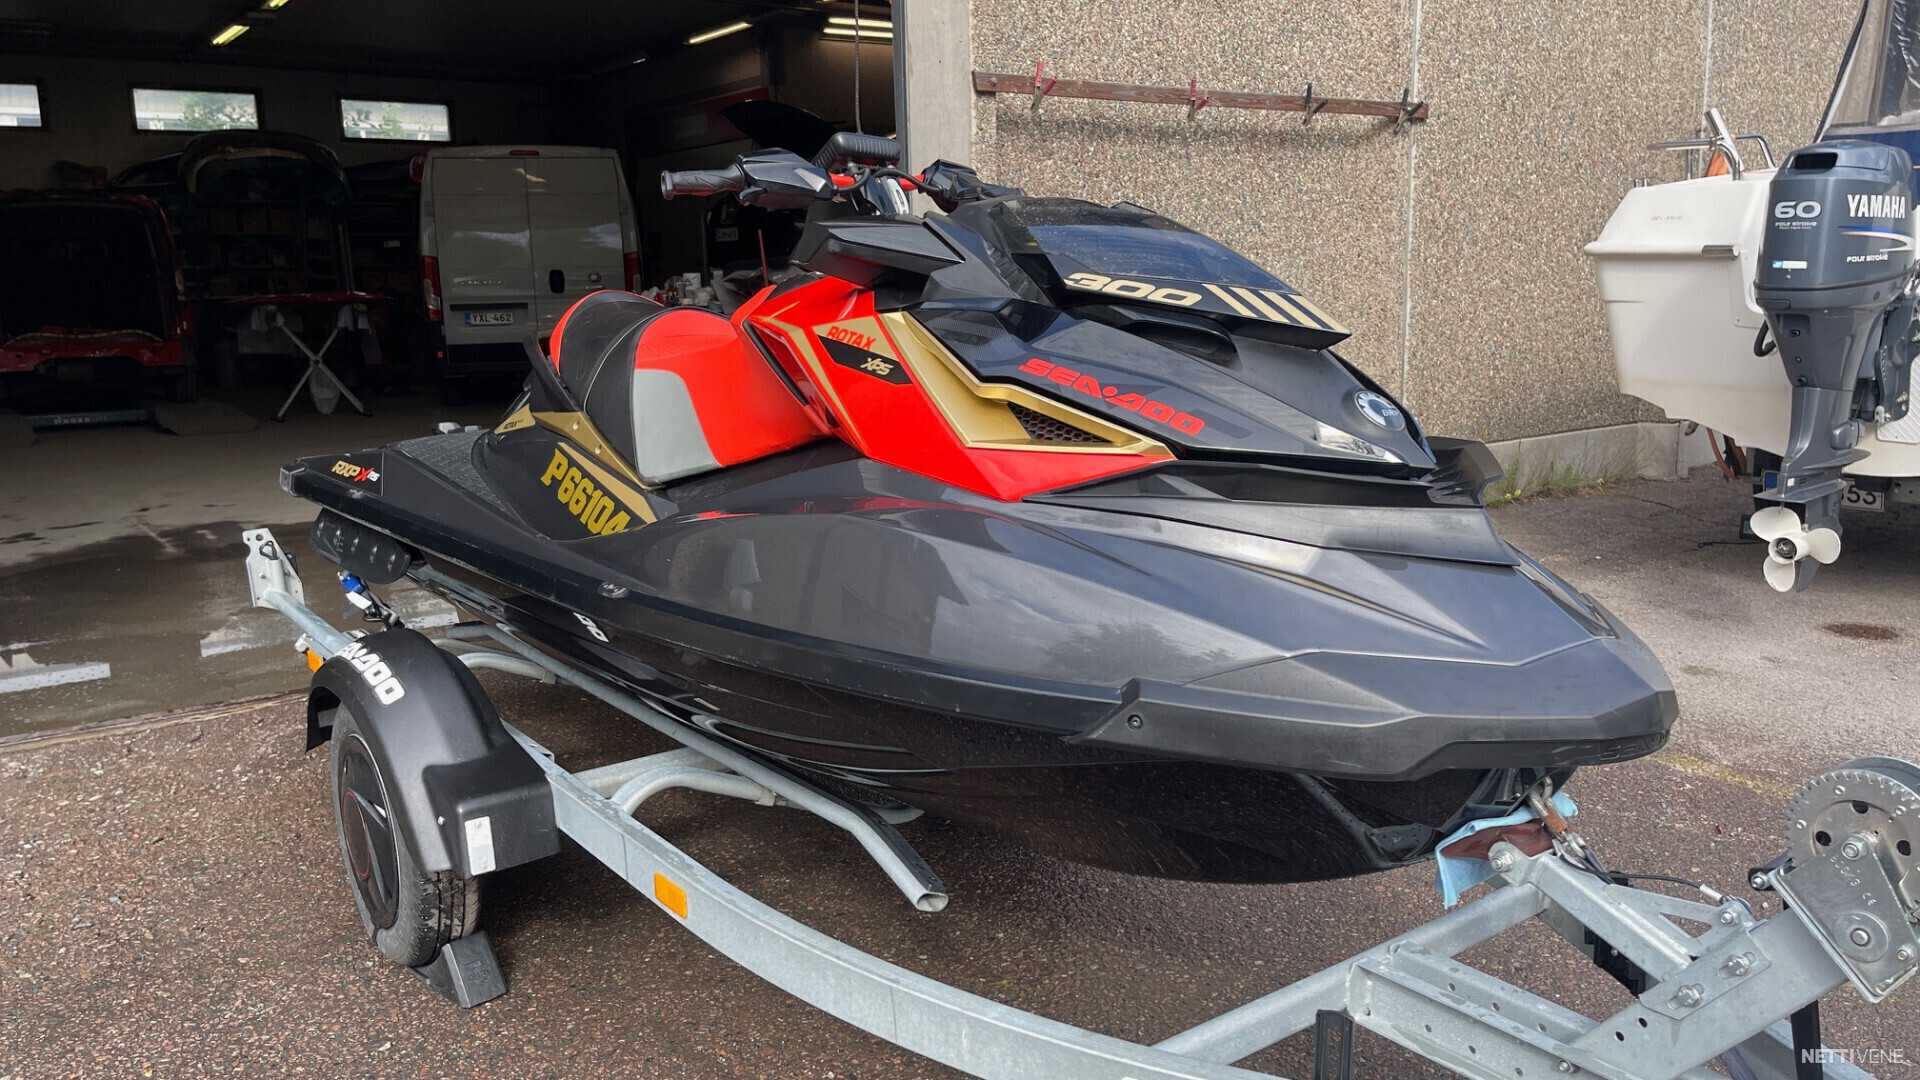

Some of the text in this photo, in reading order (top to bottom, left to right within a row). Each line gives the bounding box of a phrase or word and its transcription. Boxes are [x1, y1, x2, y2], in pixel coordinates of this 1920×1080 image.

[1774, 200, 1821, 219] 60
[1847, 194, 1906, 219] YAMAHA
[1063, 272, 1203, 307] 300
[472, 313, 513, 323] YXL-462
[826, 325, 877, 351] ROTAX
[860, 357, 894, 375] XPS
